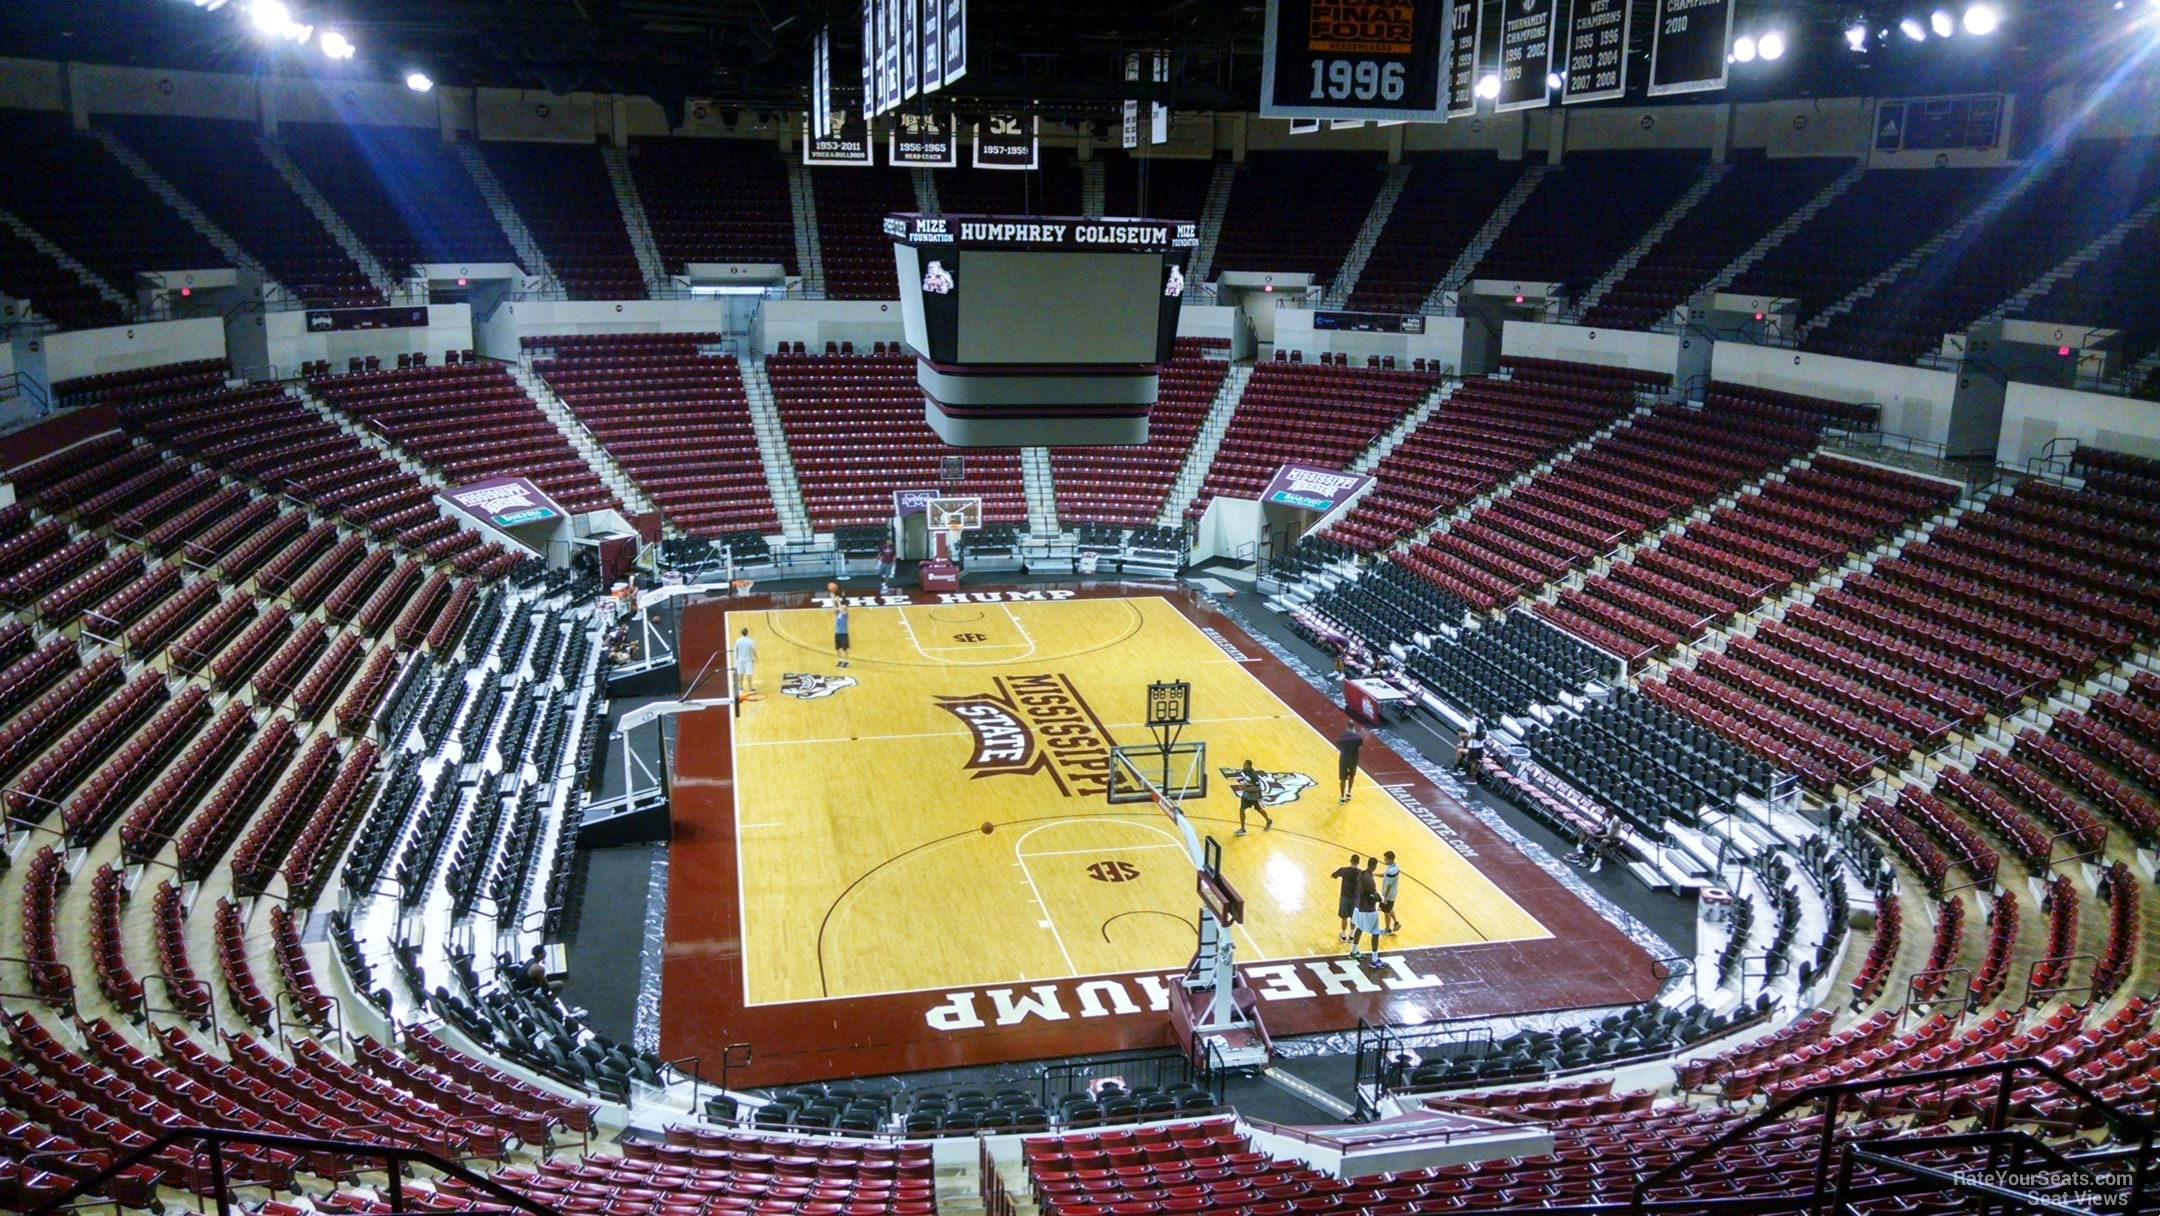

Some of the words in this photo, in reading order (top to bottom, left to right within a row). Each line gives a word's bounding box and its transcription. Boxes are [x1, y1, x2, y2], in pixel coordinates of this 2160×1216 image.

[1311, 5, 1414, 23] FINAL
[1591, 0, 1609, 13] WEST
[1507, 12, 1547, 31] TOURNAMENT
[1577, 10, 1621, 30] CHAMPIONS
[1665, 15, 1688, 35] 2010
[1310, 22, 1414, 41] FOUR
[1506, 26, 1546, 44] CHAMPIONS
[1575, 34, 1594, 50] 1995
[1600, 29, 1619, 45] 1996
[1328, 42, 1393, 50] MEADOWLANDS
[1506, 48, 1522, 62] 1996
[1527, 43, 1546, 59] 2002
[1572, 55, 1593, 71] 2003
[1597, 49, 1618, 67] 2004
[1310, 59, 1405, 100] 1996
[1504, 66, 1522, 81] 2009
[1571, 75, 1591, 91] 2007
[1596, 71, 1616, 88] 2008
[816, 141, 861, 151] 1953-2011
[900, 143, 946, 152] 1956-1965
[983, 145, 1028, 155] 1957-1959
[916, 219, 946, 232] MIZE
[961, 223, 1066, 242] HUMPHREY
[1075, 225, 1167, 244] COLISEUM
[1177, 224, 1196, 238] MIZE
[909, 232, 954, 243] FOUNDATION
[1172, 237, 1199, 247] FOUNDATION
[937, 590, 1076, 605] HUMP
[953, 632, 988, 643] SEC
[955, 705, 1025, 763] STATE
[1006, 673, 1135, 797] MISSISSIPPI
[1386, 785, 1479, 857] HAILSTATE.COM
[1086, 861, 1141, 882] SEC
[1244, 956, 1444, 1000] THE
